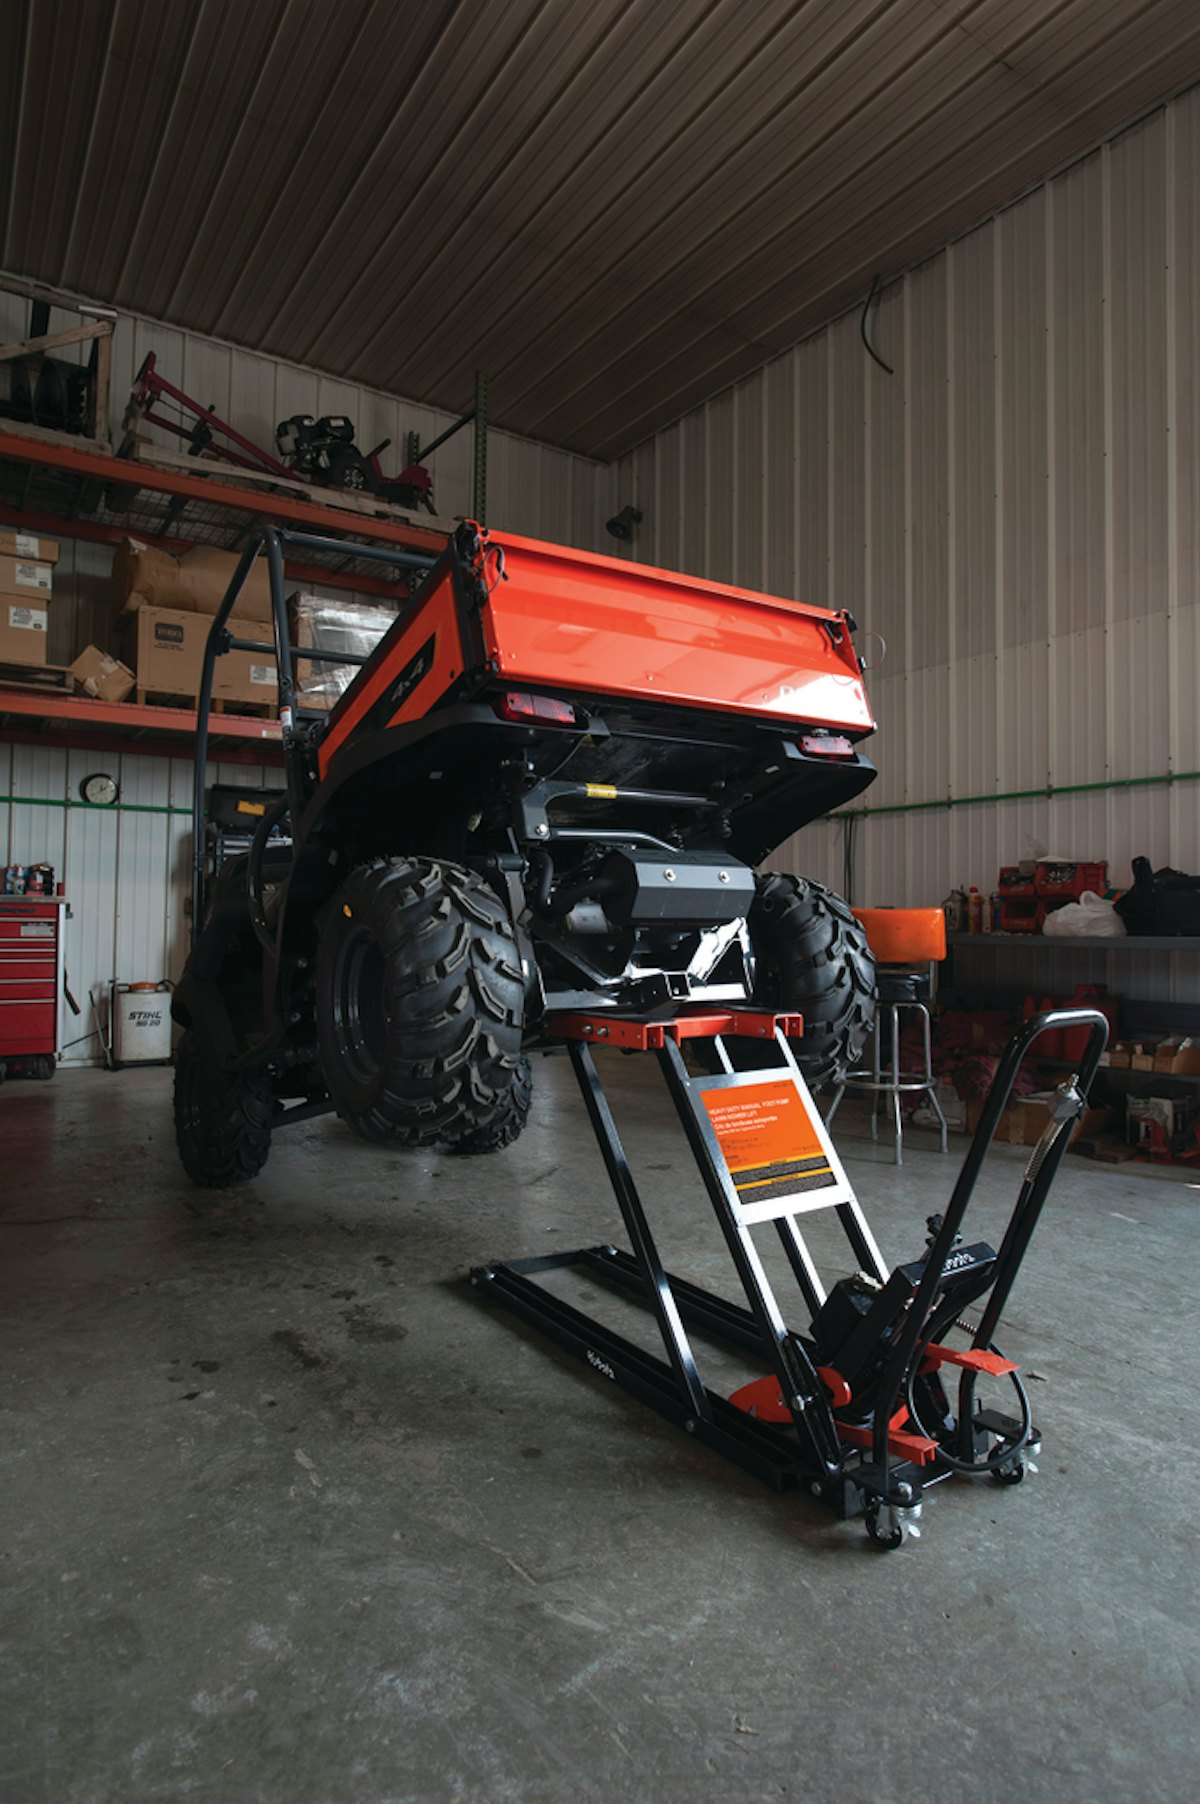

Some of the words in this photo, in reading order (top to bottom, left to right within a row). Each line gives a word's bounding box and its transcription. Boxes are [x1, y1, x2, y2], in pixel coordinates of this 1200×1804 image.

[128, 1011, 162, 1020] STIHL
[708, 1106, 727, 1115] HEAVY
[741, 1103, 761, 1111] MANUAL
[727, 1112, 747, 1121] MOWER
